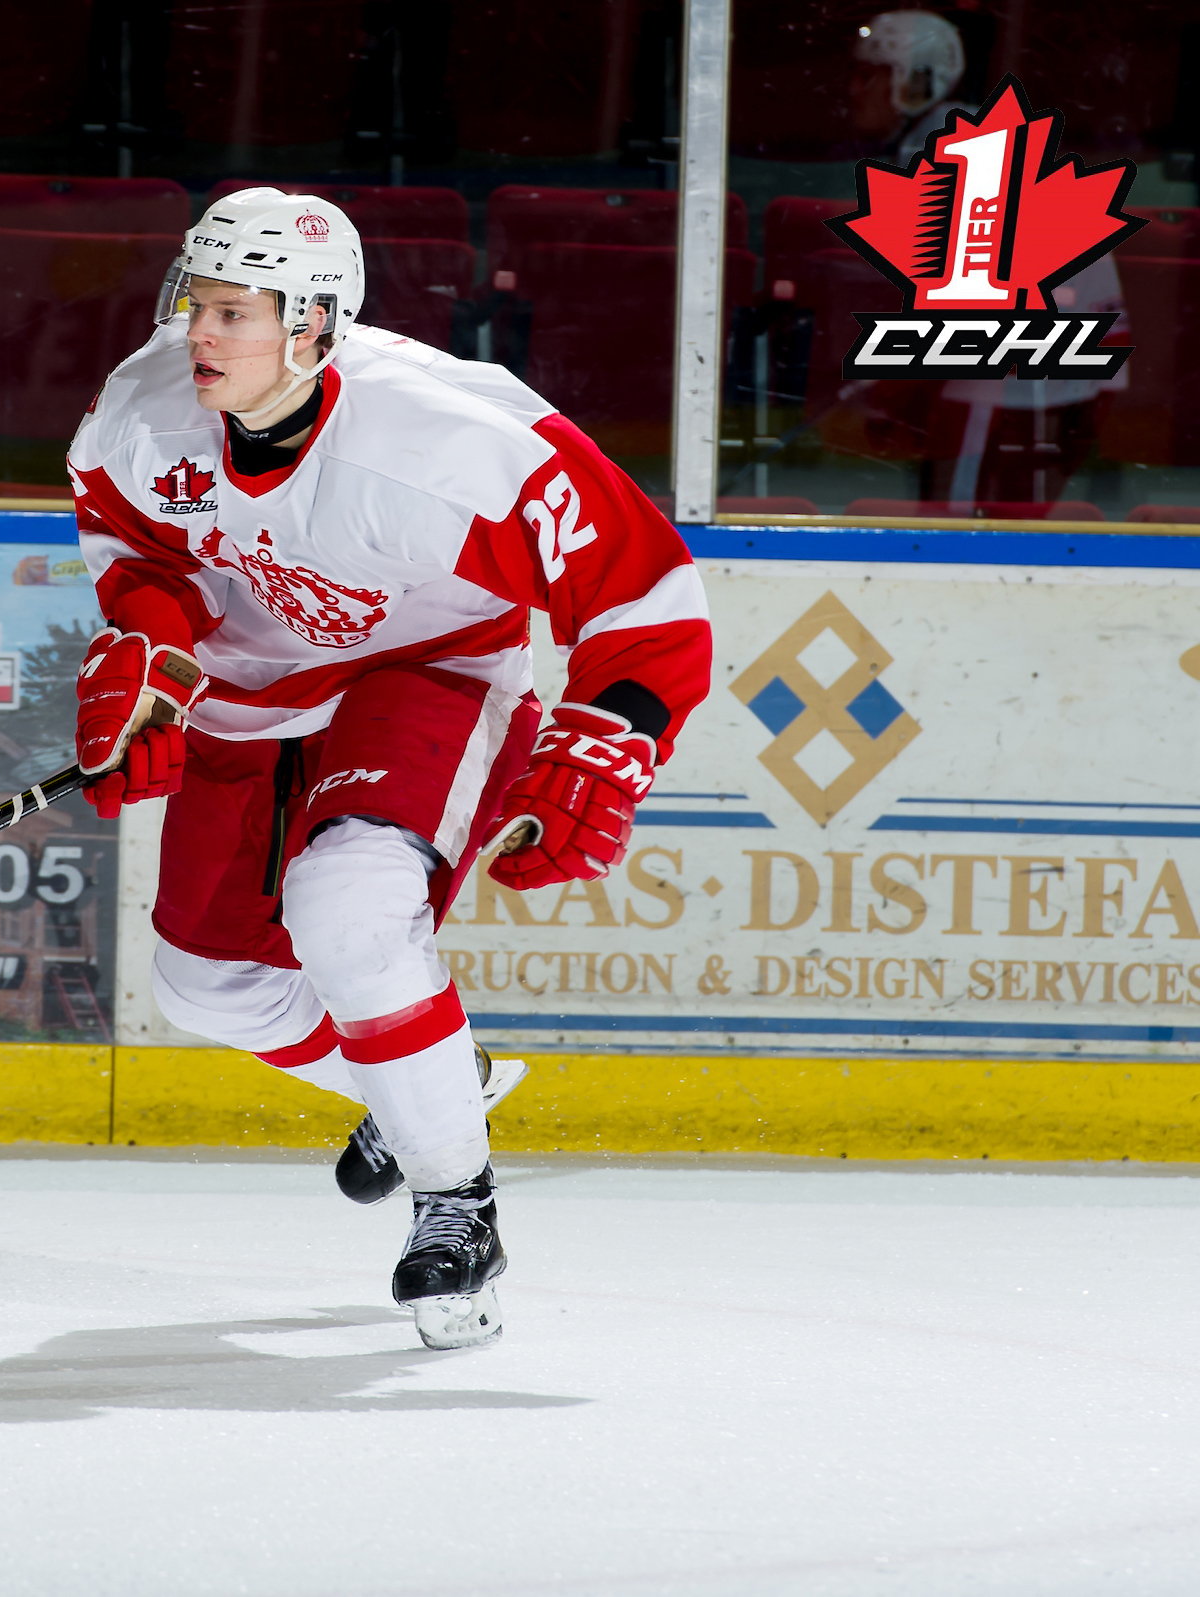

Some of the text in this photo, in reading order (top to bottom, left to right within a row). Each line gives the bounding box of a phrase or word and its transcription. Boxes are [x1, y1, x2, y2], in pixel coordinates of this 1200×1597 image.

[193, 235, 231, 250] CCM
[310, 273, 343, 282] CCM
[160, 501, 218, 514] CCHL
[522, 470, 599, 584] 22
[166, 662, 196, 681] CCM
[530, 730, 653, 795] CCM
[306, 768, 388, 813] CCM
[739, 849, 1200, 940] DISTEFA
[697, 954, 732, 996] &
[754, 955, 948, 1000] DESIGN
